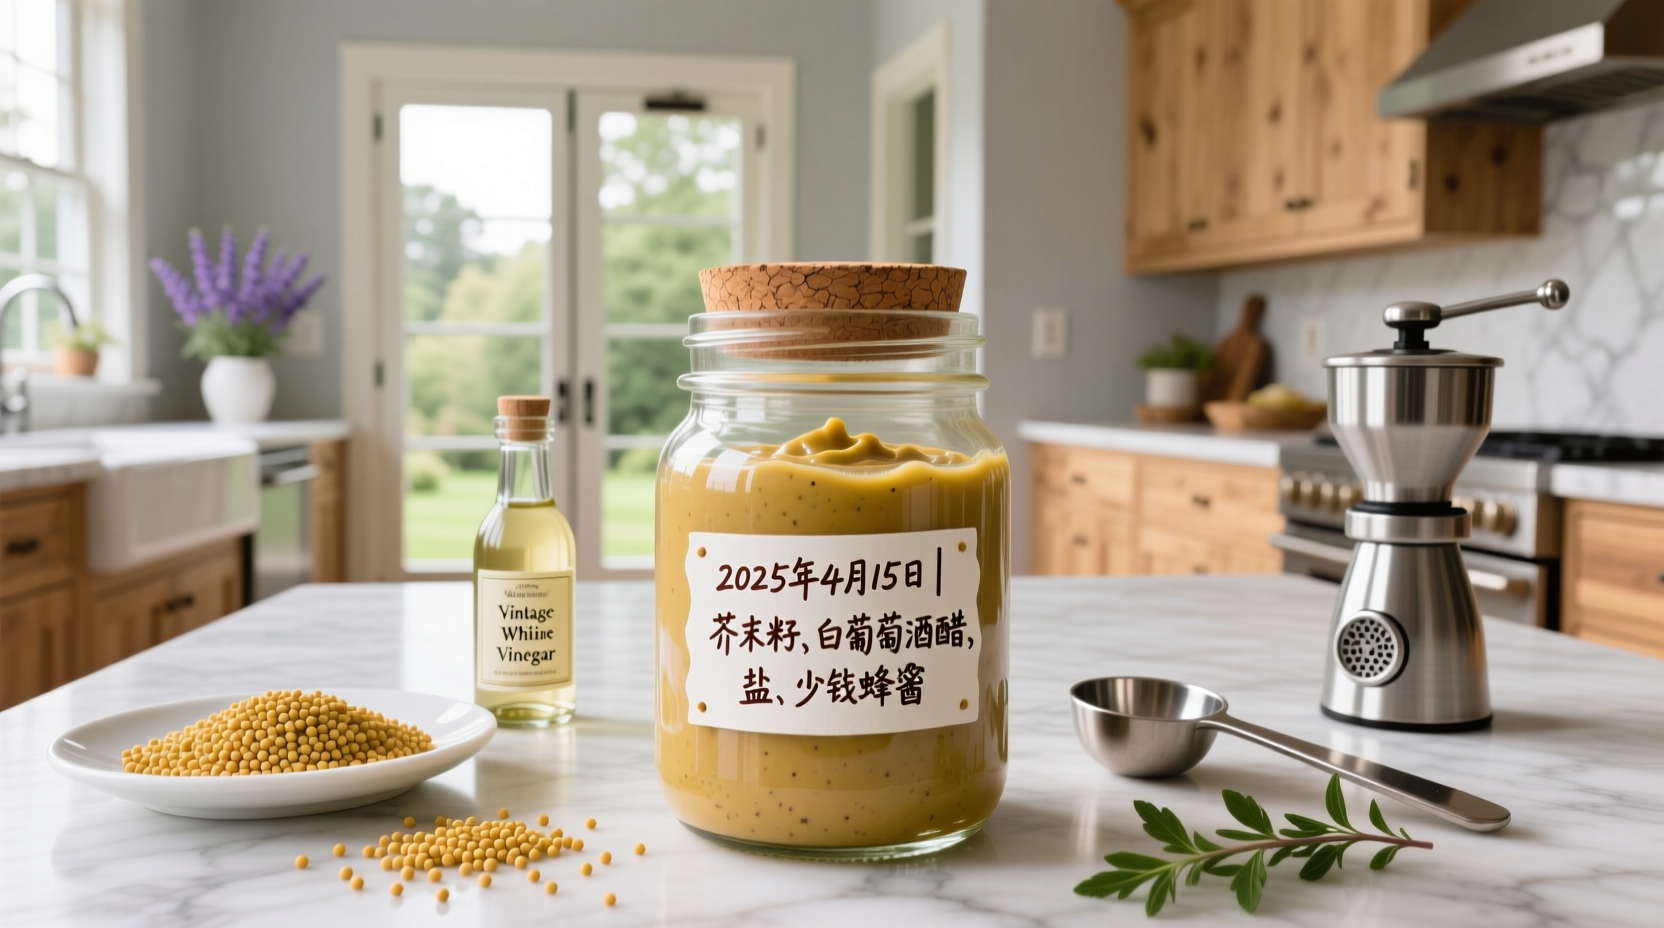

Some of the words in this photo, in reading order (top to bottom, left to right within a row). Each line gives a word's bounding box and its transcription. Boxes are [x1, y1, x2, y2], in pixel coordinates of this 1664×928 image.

[715, 556, 922, 602] 2025年4月15日
[498, 604, 555, 623] Vintage
[496, 646, 556, 666] Vinegar
